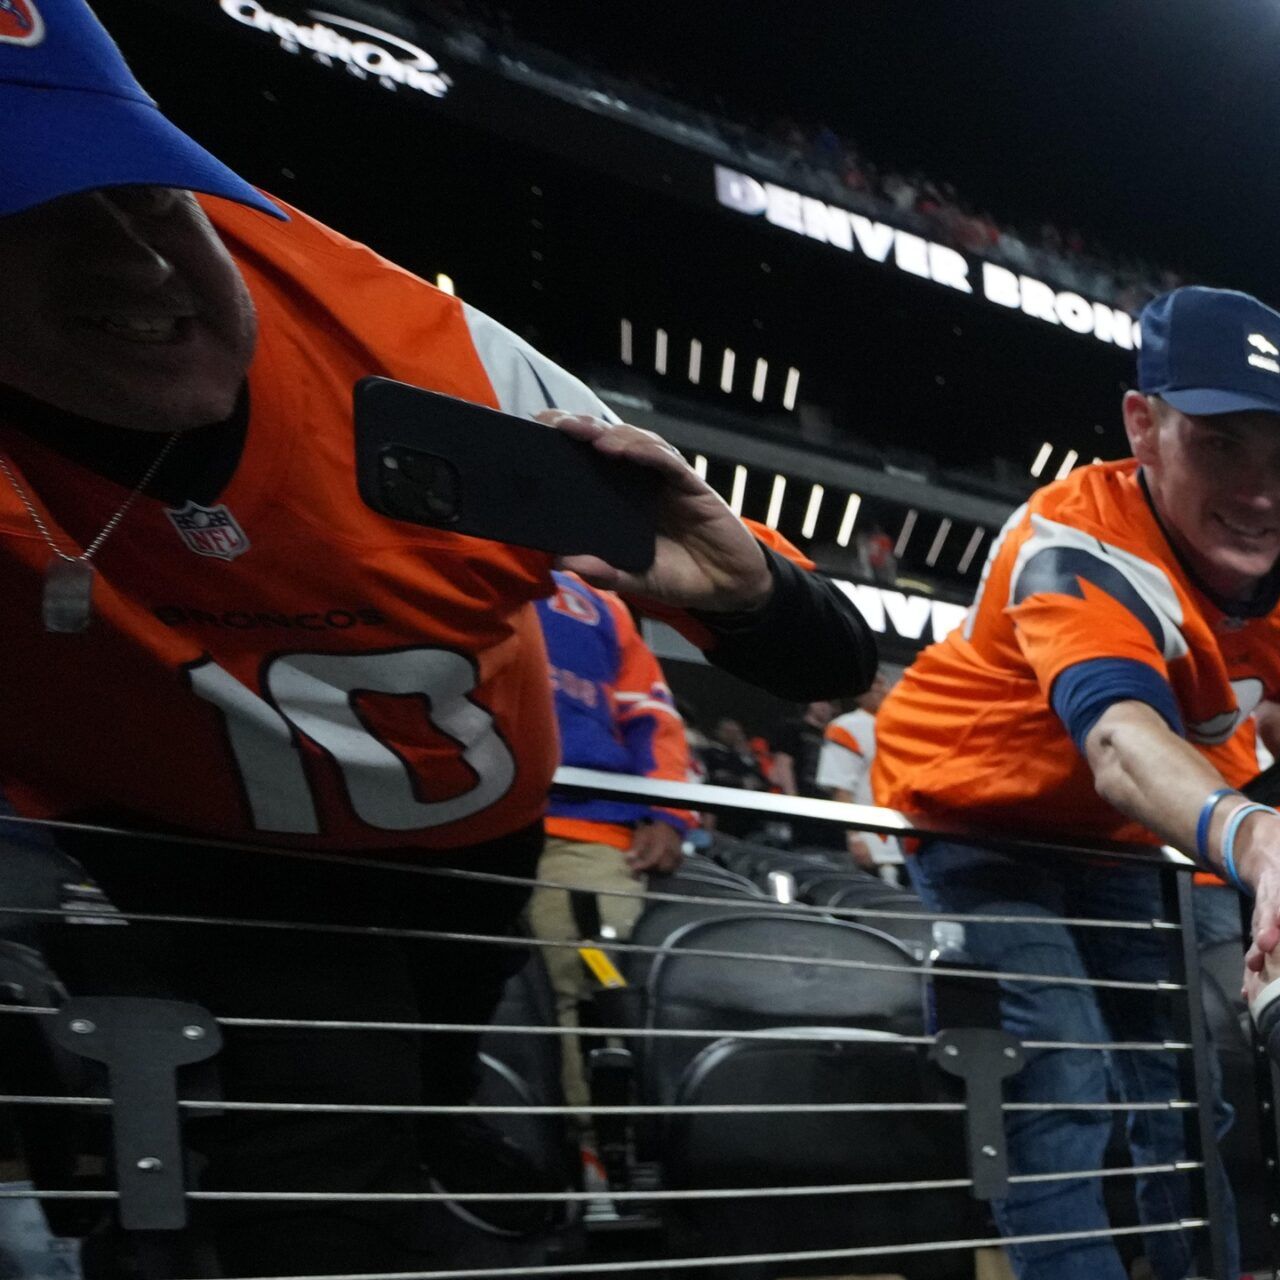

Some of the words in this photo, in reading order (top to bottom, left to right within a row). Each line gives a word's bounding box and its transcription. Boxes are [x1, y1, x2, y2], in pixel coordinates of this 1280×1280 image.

[714, 164, 973, 295] DENVER
[982, 262, 1141, 351] BRON
[190, 526, 239, 553] NFL
[152, 605, 386, 631] BRONCOS
[181, 644, 517, 834] 10
